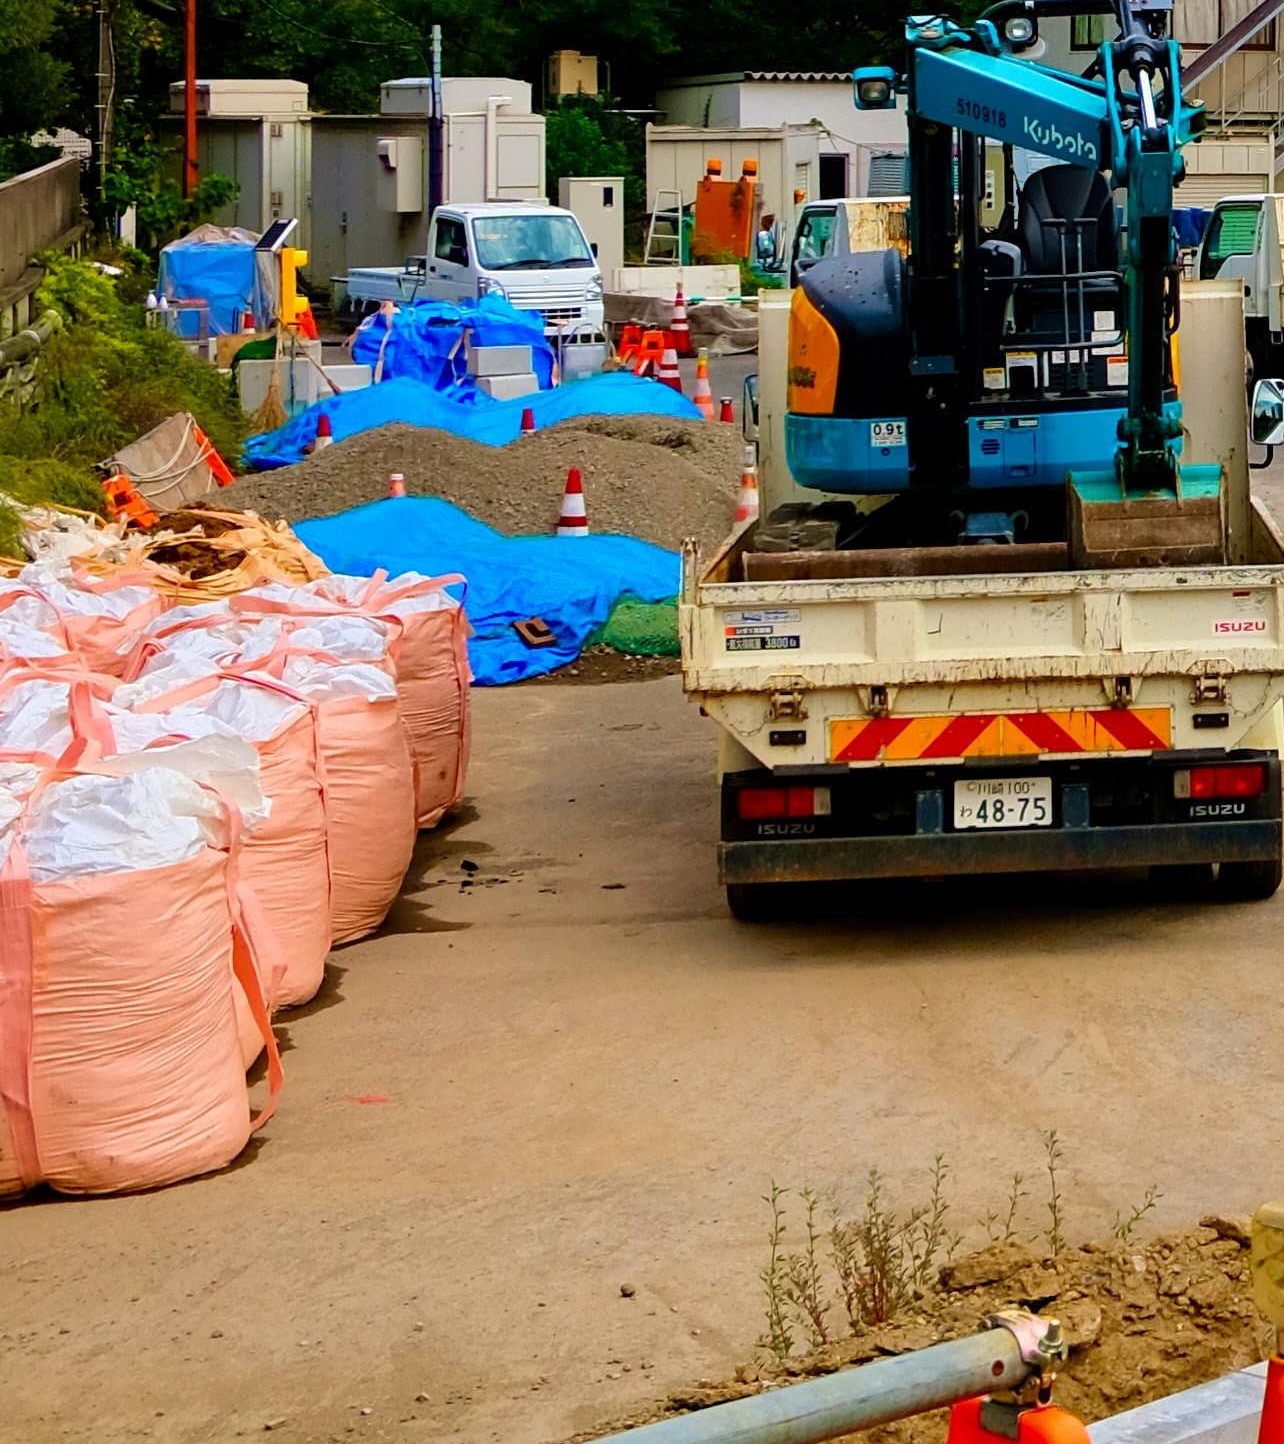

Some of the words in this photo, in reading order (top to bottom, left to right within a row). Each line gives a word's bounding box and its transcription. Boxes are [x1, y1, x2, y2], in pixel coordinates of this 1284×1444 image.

[956, 98, 1007, 128] 510918
[1023, 116, 1097, 161] Kubota
[1215, 621, 1266, 633] ISUZU
[960, 806, 973, 818] わ
[976, 797, 1046, 823] 48-75
[1190, 803, 1246, 816] ISUZU
[757, 823, 816, 835] ISUZU
